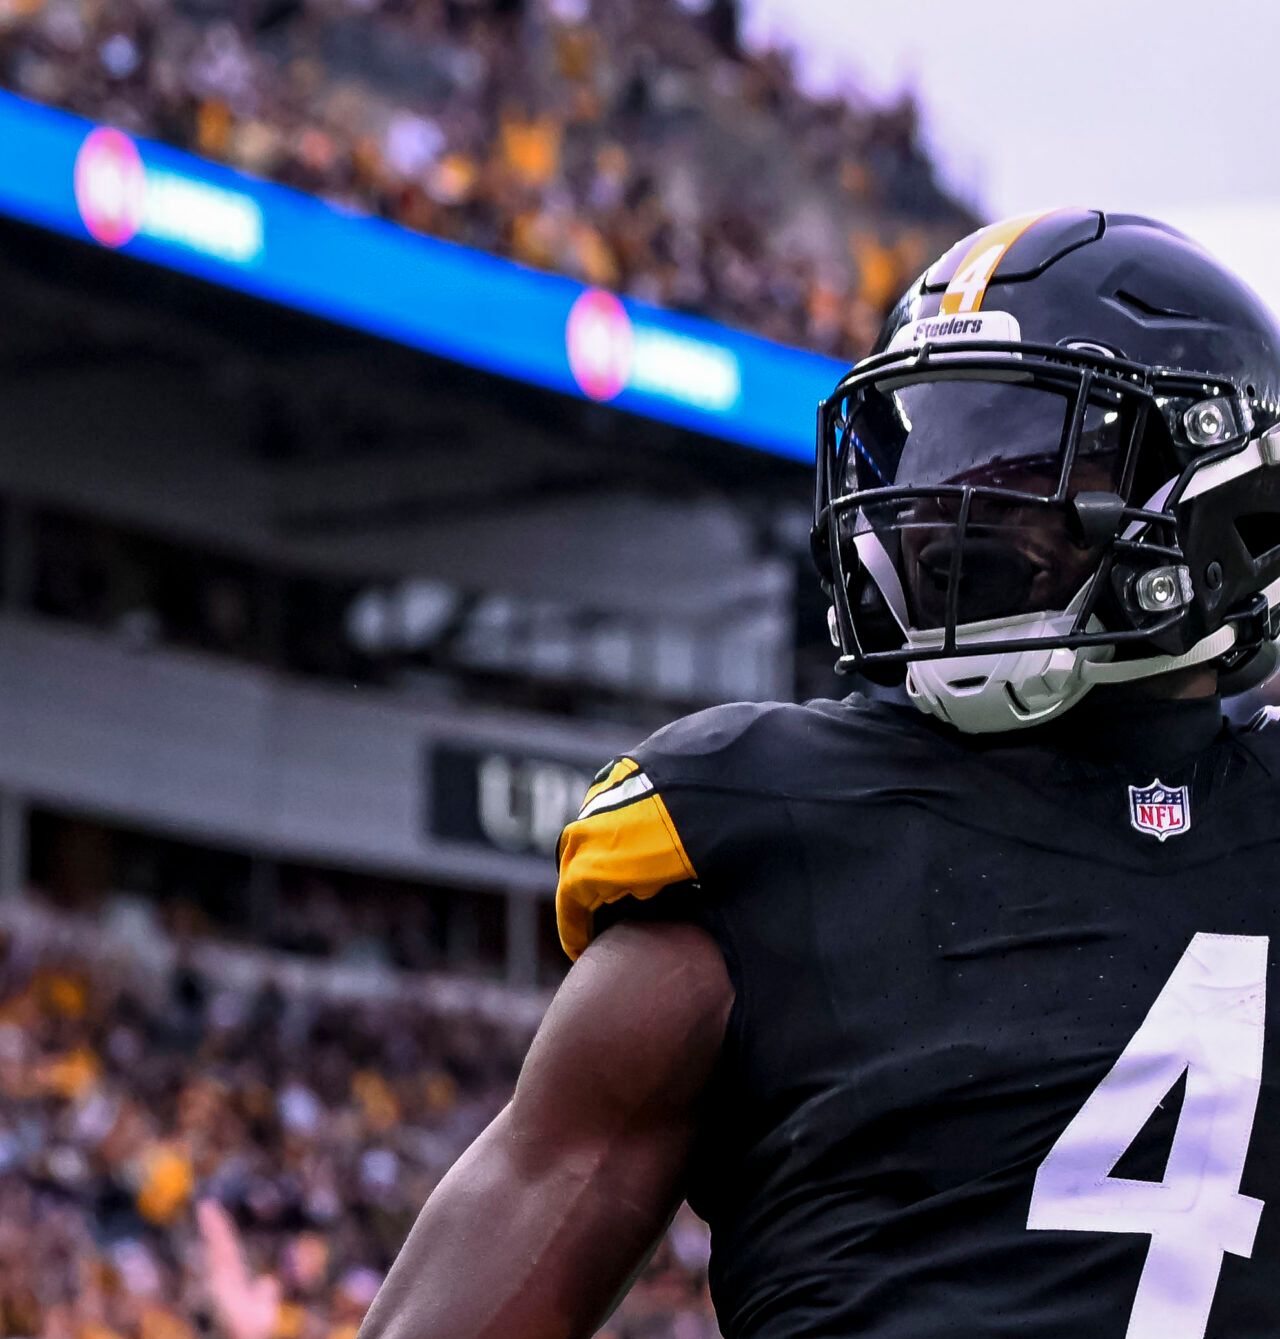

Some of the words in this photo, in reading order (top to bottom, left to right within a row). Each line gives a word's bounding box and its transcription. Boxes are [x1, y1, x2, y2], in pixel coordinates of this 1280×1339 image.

[945, 243, 1005, 312] 4
[913, 317, 983, 341] Steelers
[1139, 804, 1180, 828] NFL
